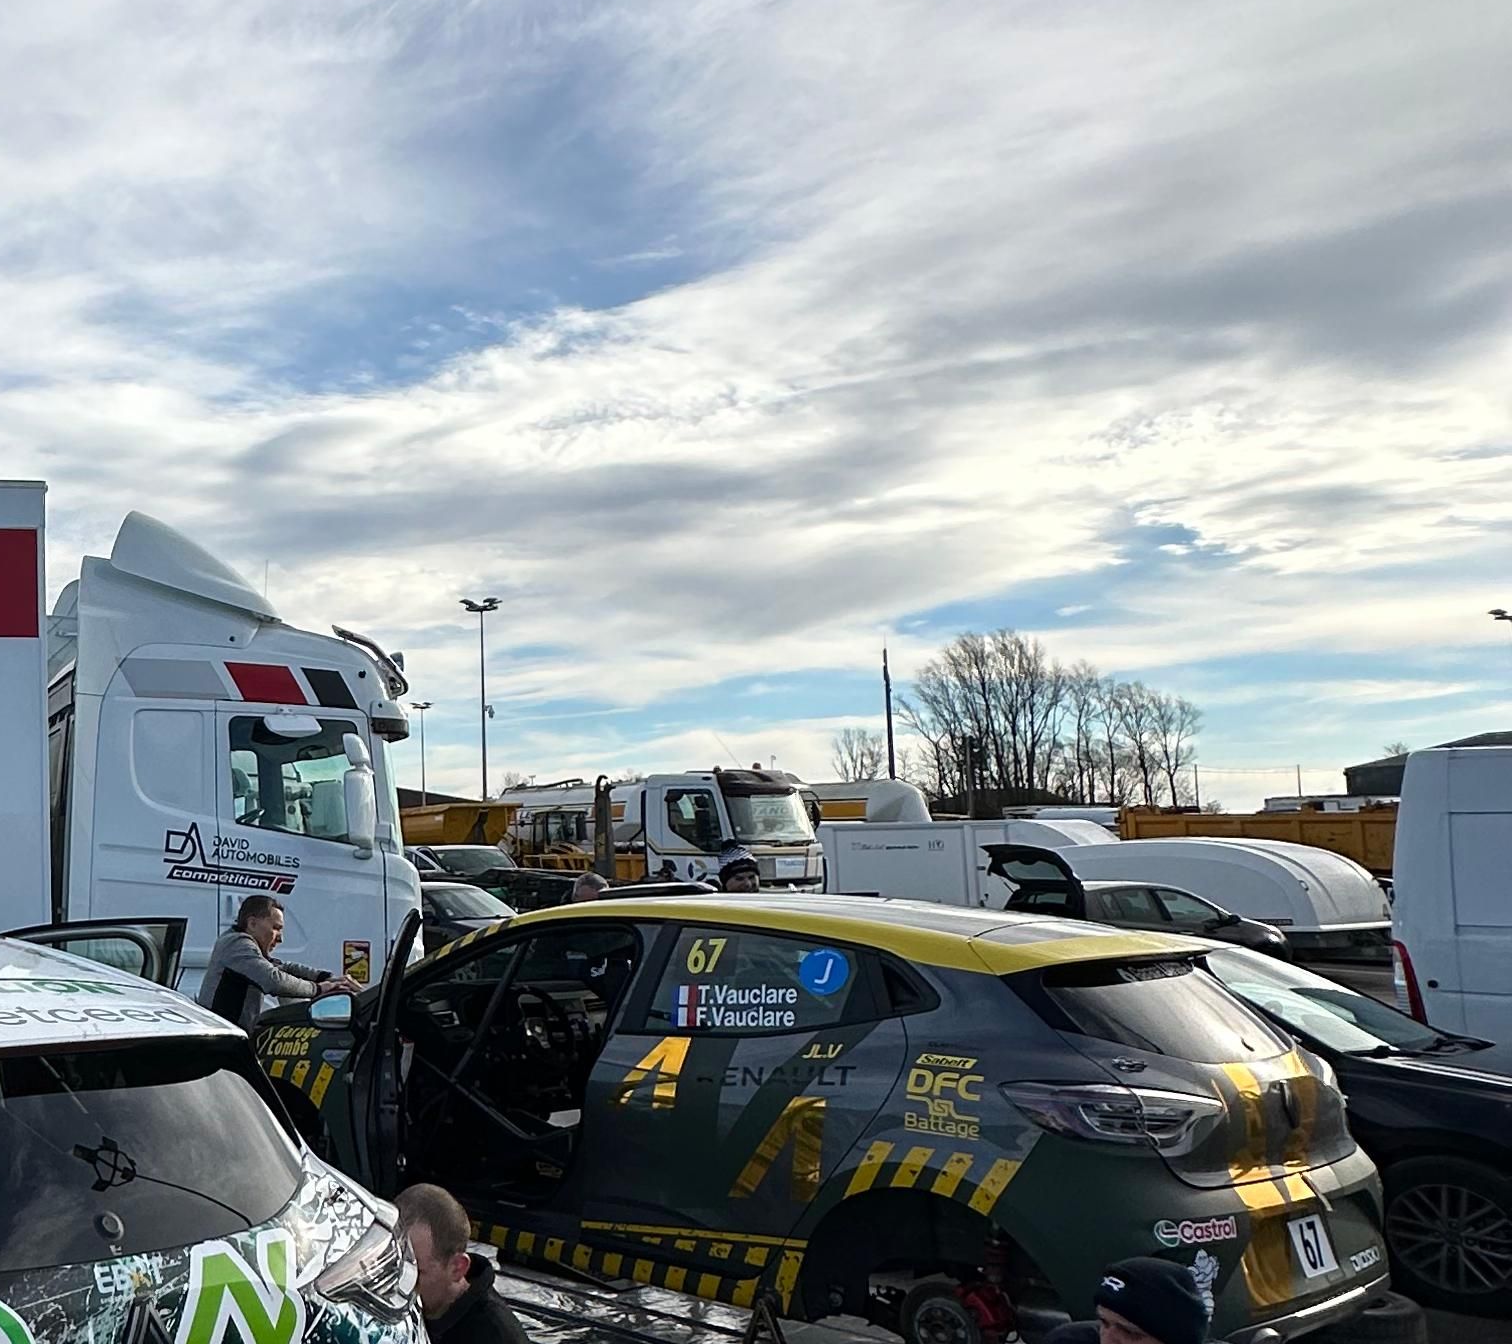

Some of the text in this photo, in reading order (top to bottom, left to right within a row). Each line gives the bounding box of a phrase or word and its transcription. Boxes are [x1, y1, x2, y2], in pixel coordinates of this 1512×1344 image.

[212, 835, 250, 851] DAVID
[211, 847, 301, 869] AUTOMOBILES
[172, 869, 270, 889] compétition
[686, 937, 728, 975] 67
[814, 958, 834, 985] J
[274, 1026, 322, 1042] Garage
[268, 1039, 309, 1056] Combe
[921, 1054, 971, 1069] Sabelt
[696, 1065, 857, 1087] ENAULT
[906, 1068, 985, 1101] DFC
[904, 1112, 980, 1138] Battage
[1180, 1215, 1238, 1244] Castrol
[1298, 1220, 1326, 1271] 67
